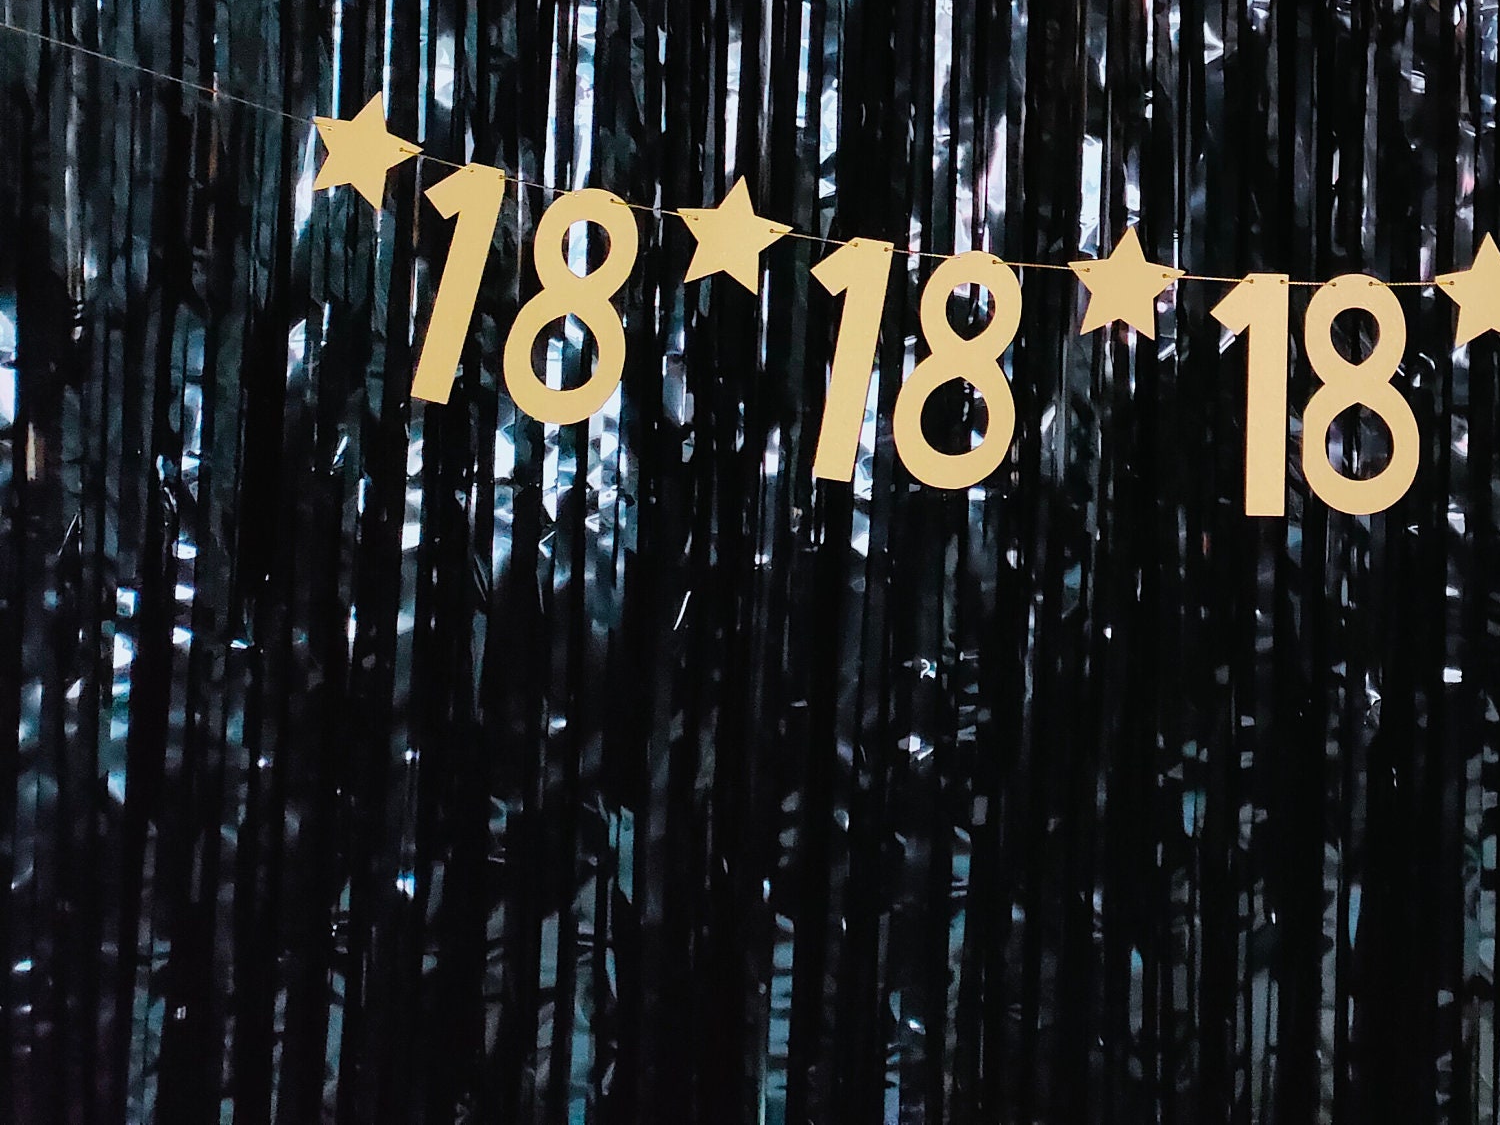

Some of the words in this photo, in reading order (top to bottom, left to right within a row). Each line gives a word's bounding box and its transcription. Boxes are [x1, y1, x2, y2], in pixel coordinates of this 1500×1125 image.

[411, 162, 638, 426] 18
[810, 237, 1023, 489] 18
[1210, 272, 1420, 517] 18
